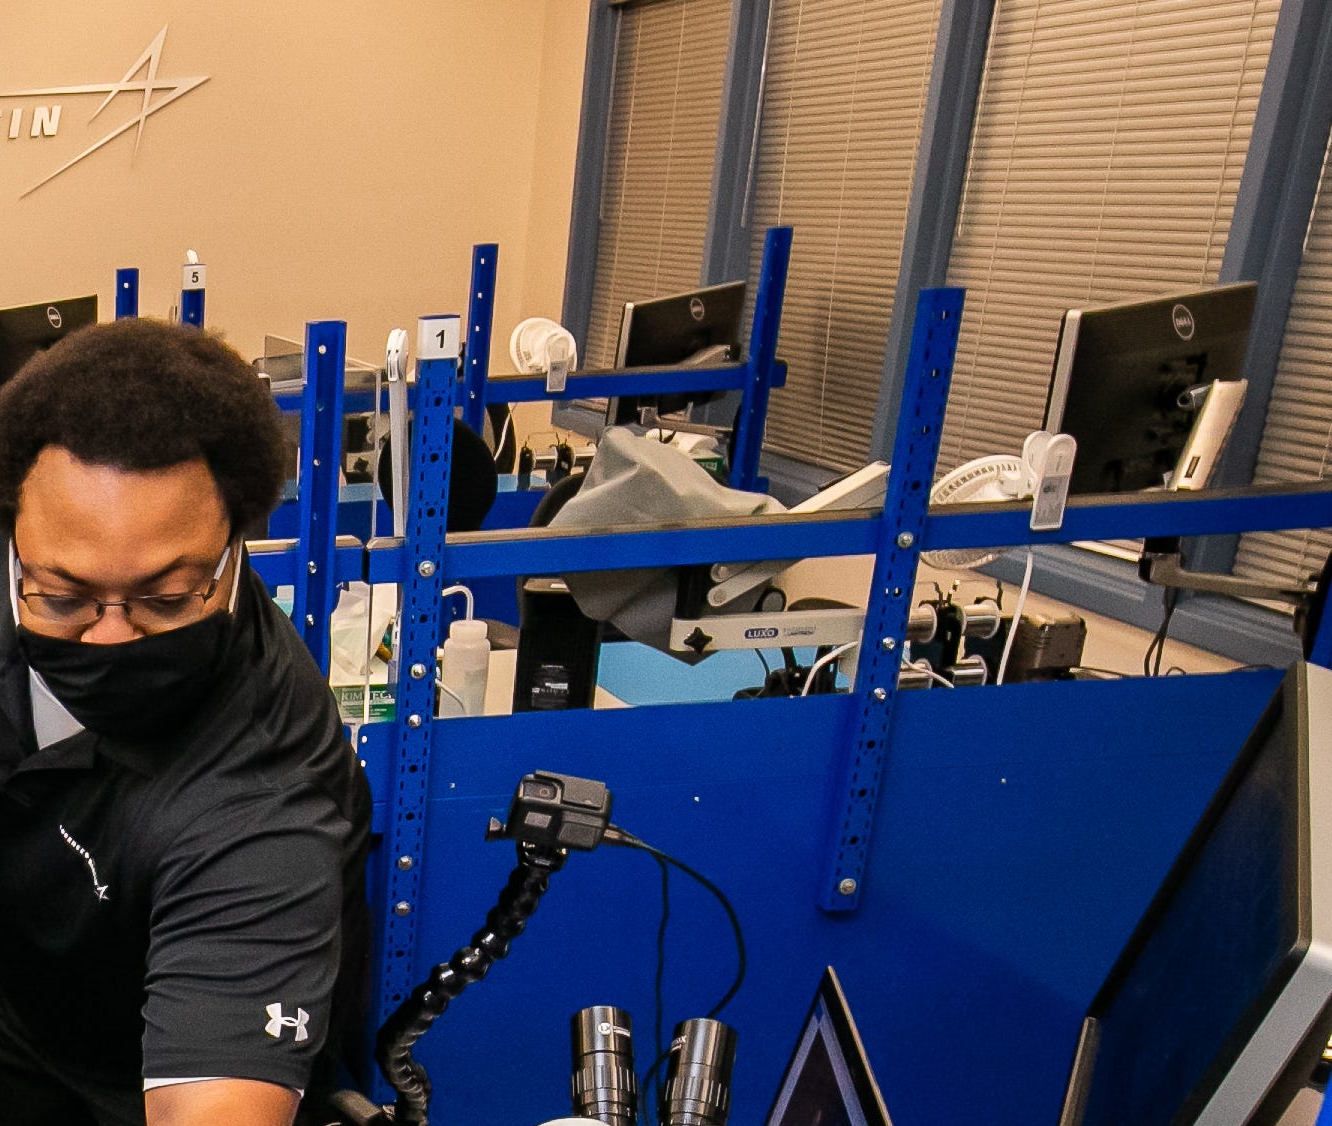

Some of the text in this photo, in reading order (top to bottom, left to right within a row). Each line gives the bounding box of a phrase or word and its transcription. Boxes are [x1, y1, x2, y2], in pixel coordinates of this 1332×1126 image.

[191, 271, 199, 283] 5
[435, 329, 445, 348] 1
[747, 628, 775, 639] LUXO
[341, 690, 392, 701] KIMEC
